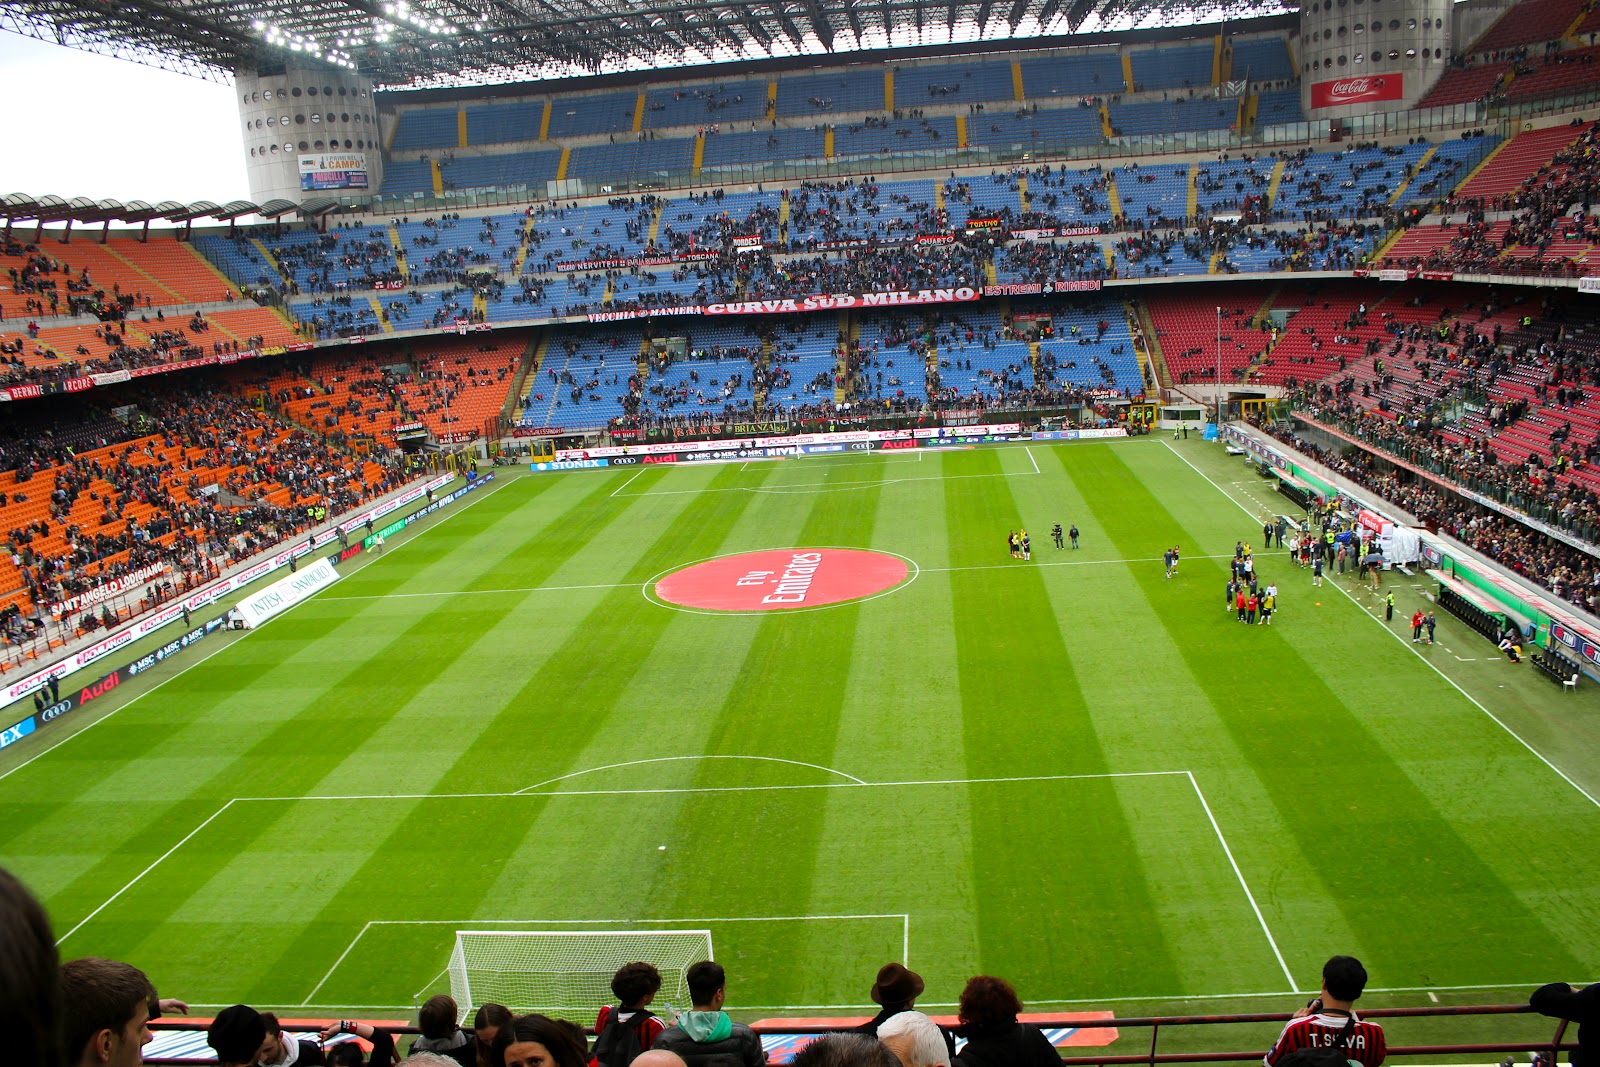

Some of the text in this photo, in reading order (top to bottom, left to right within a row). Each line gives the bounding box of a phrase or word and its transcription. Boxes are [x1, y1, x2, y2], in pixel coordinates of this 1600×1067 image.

[328, 160, 360, 169] CAMPO
[968, 219, 998, 228] TORINO
[1010, 226, 1100, 239] VASE SONDRIO
[733, 236, 761, 246] NORDEST
[919, 235, 954, 245] QUARTO
[686, 252, 719, 261] TOSCANA
[577, 260, 618, 270] NERVITESI
[984, 280, 1101, 295] ESTREMI RIMEDI
[707, 299, 798, 314] CURVA
[803, 296, 856, 310] SUD
[862, 287, 975, 306] MILANO
[587, 305, 702, 324] VECCHIA MANIERA
[11, 385, 44, 399] BERNATE
[63, 377, 91, 391] ARCORE
[734, 424, 774, 434] BRIANZA
[767, 446, 806, 456] NIVEA
[882, 439, 918, 449] Audi
[551, 460, 600, 470] STONEX
[641, 454, 677, 464] Audi
[372, 521, 403, 544] NTRILITE
[341, 542, 361, 561] Audi
[118, 561, 164, 589] LODIGIANO
[735, 570, 775, 587] Fly
[761, 552, 823, 605] Emirates
[250, 565, 330, 616] INTESA SANPAOLO
[189, 627, 204, 641] MSC
[1562, 631, 1575, 646] TIM
[83, 632, 132, 662] ACMILAN.com
[163, 641, 180, 655] MSC
[137, 655, 155, 669] MSC
[79, 672, 121, 705] Audi
[0, 723, 24, 748] EX
[1309, 1033, 1366, 1050] T.SVA
